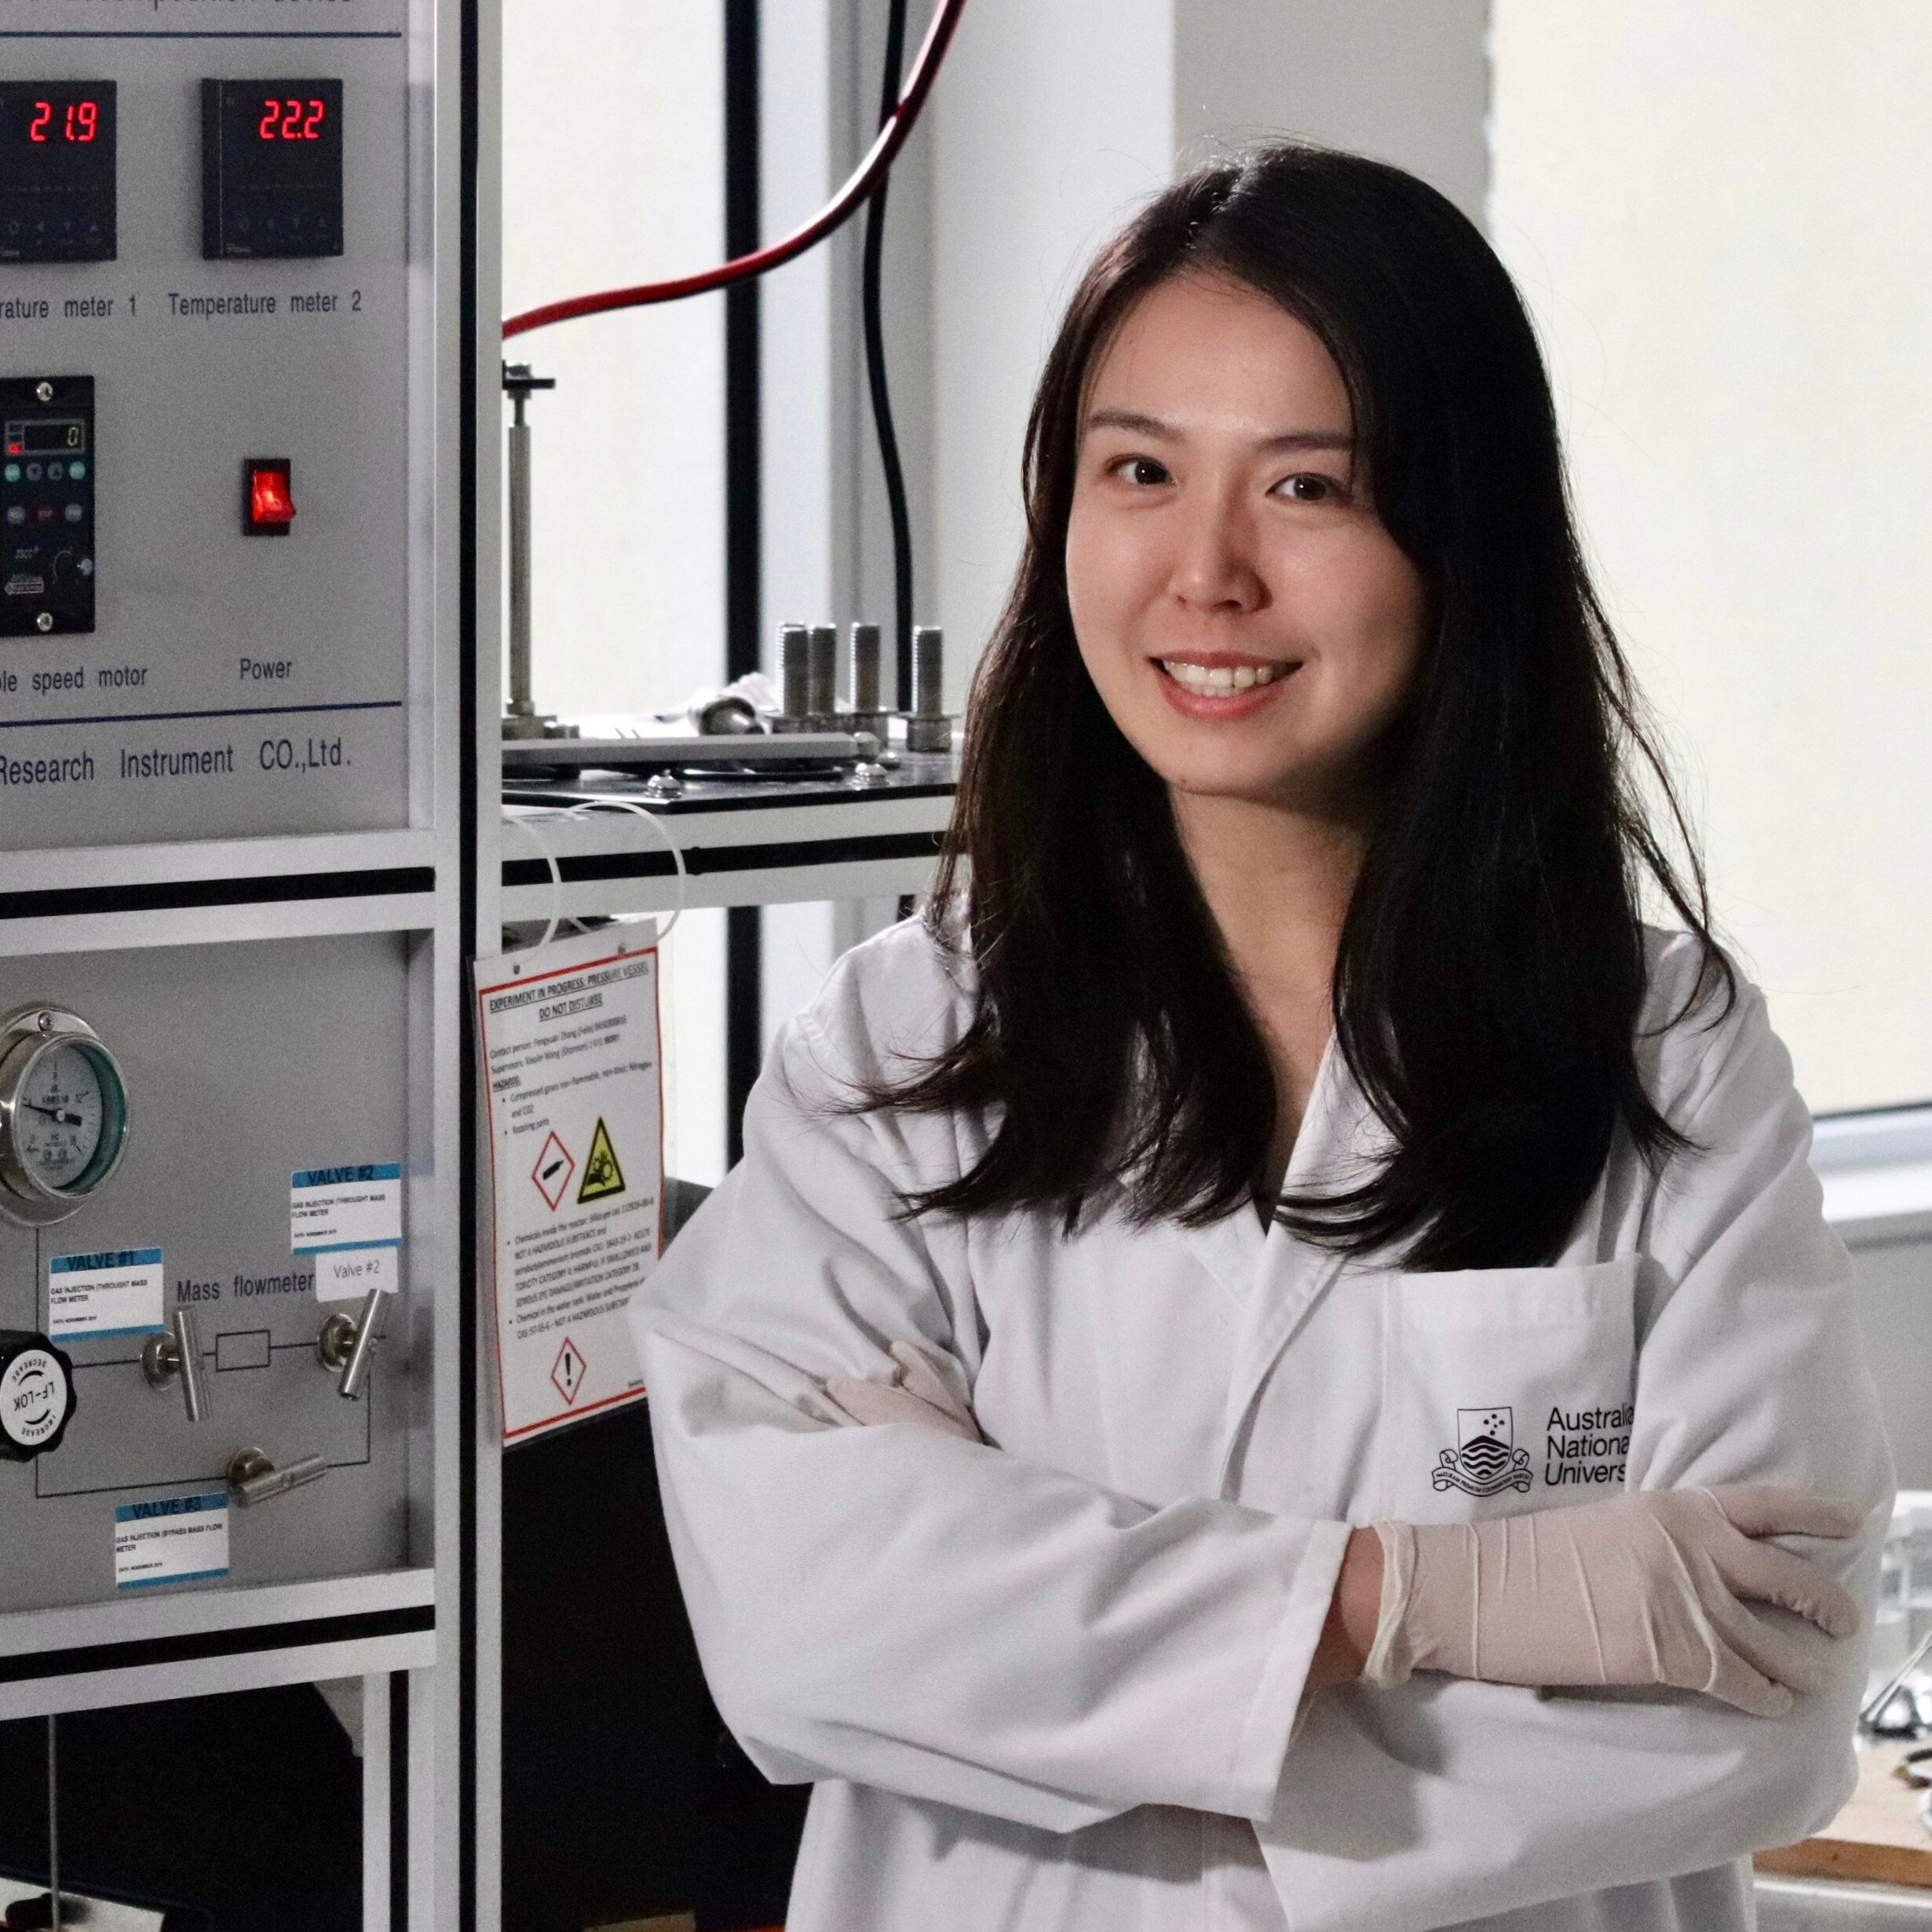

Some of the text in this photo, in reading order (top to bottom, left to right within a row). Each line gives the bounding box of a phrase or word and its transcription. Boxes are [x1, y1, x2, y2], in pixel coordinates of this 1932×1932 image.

[30, 100, 97, 141] 21.9
[259, 100, 325, 139] 22.2
[64, 297, 113, 317] meter
[129, 294, 135, 316] 1
[168, 290, 361, 320] Temperature meter 2
[240, 658, 292, 680] Power
[0, 666, 148, 696] le speed motor
[0, 751, 94, 784] Research
[121, 745, 234, 779] Instrument
[490, 990, 535, 1010] EXPERIMENT
[537, 988, 545, 999] IN
[587, 968, 621, 986] PRESSURE
[539, 1006, 550, 1019] DO
[552, 1003, 566, 1016] NOT
[308, 1167, 352, 1186] VALVE
[67, 1251, 115, 1271] VALVE
[334, 1259, 380, 1279] Valve #2
[50, 1287, 63, 1295] GAS
[64, 1284, 94, 1294] INJECTION
[177, 1272, 314, 1302] Mass flowmeter
[68, 1295, 89, 1303] METER
[13, 1382, 54, 1412] LF-LOK
[1547, 1403, 1634, 1431] Australia
[1547, 1434, 1630, 1459] Nationa
[1545, 1463, 1627, 1486] Univers
[132, 1498, 181, 1519] VALVE
[115, 1535, 129, 1543] GAS
[130, 1531, 160, 1540] INJECTION
[188, 1525, 204, 1533] MASS
[116, 1543, 137, 1553] METER
